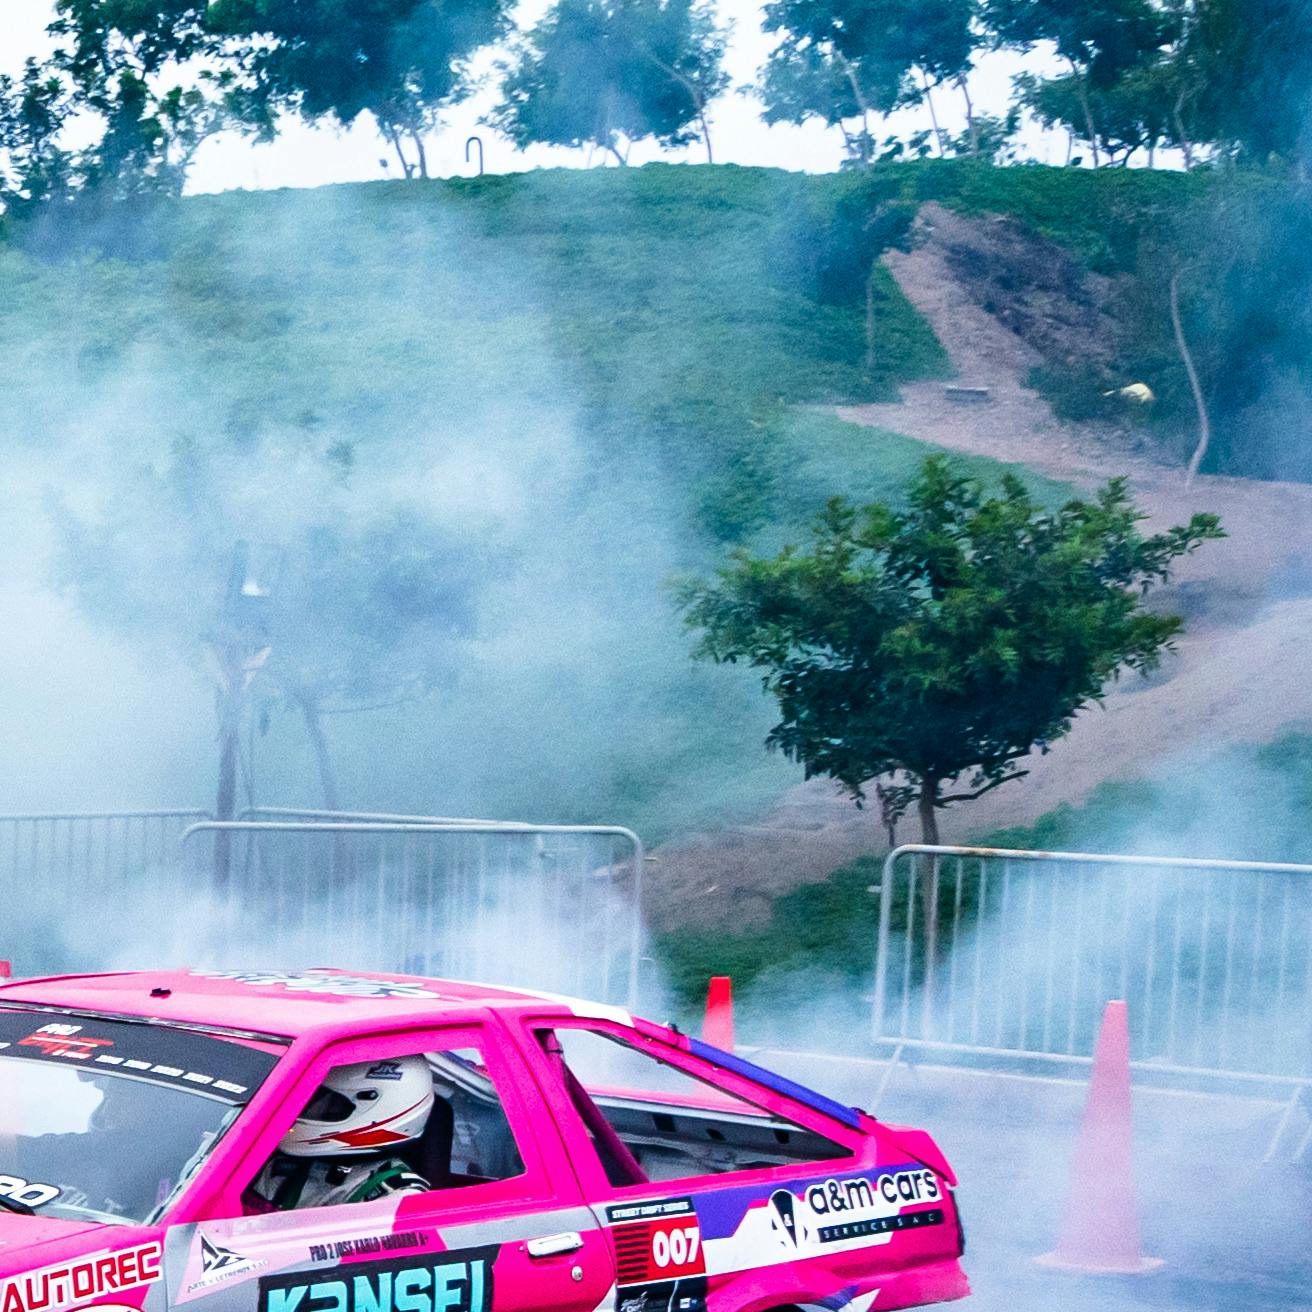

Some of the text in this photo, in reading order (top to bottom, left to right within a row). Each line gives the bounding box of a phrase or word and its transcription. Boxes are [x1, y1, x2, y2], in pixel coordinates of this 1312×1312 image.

[808, 1171, 938, 1214] a&m cars
[824, 1220, 887, 1239] SERVICE
[327, 1243, 334, 1259] 2
[652, 1227, 700, 1268] 007
